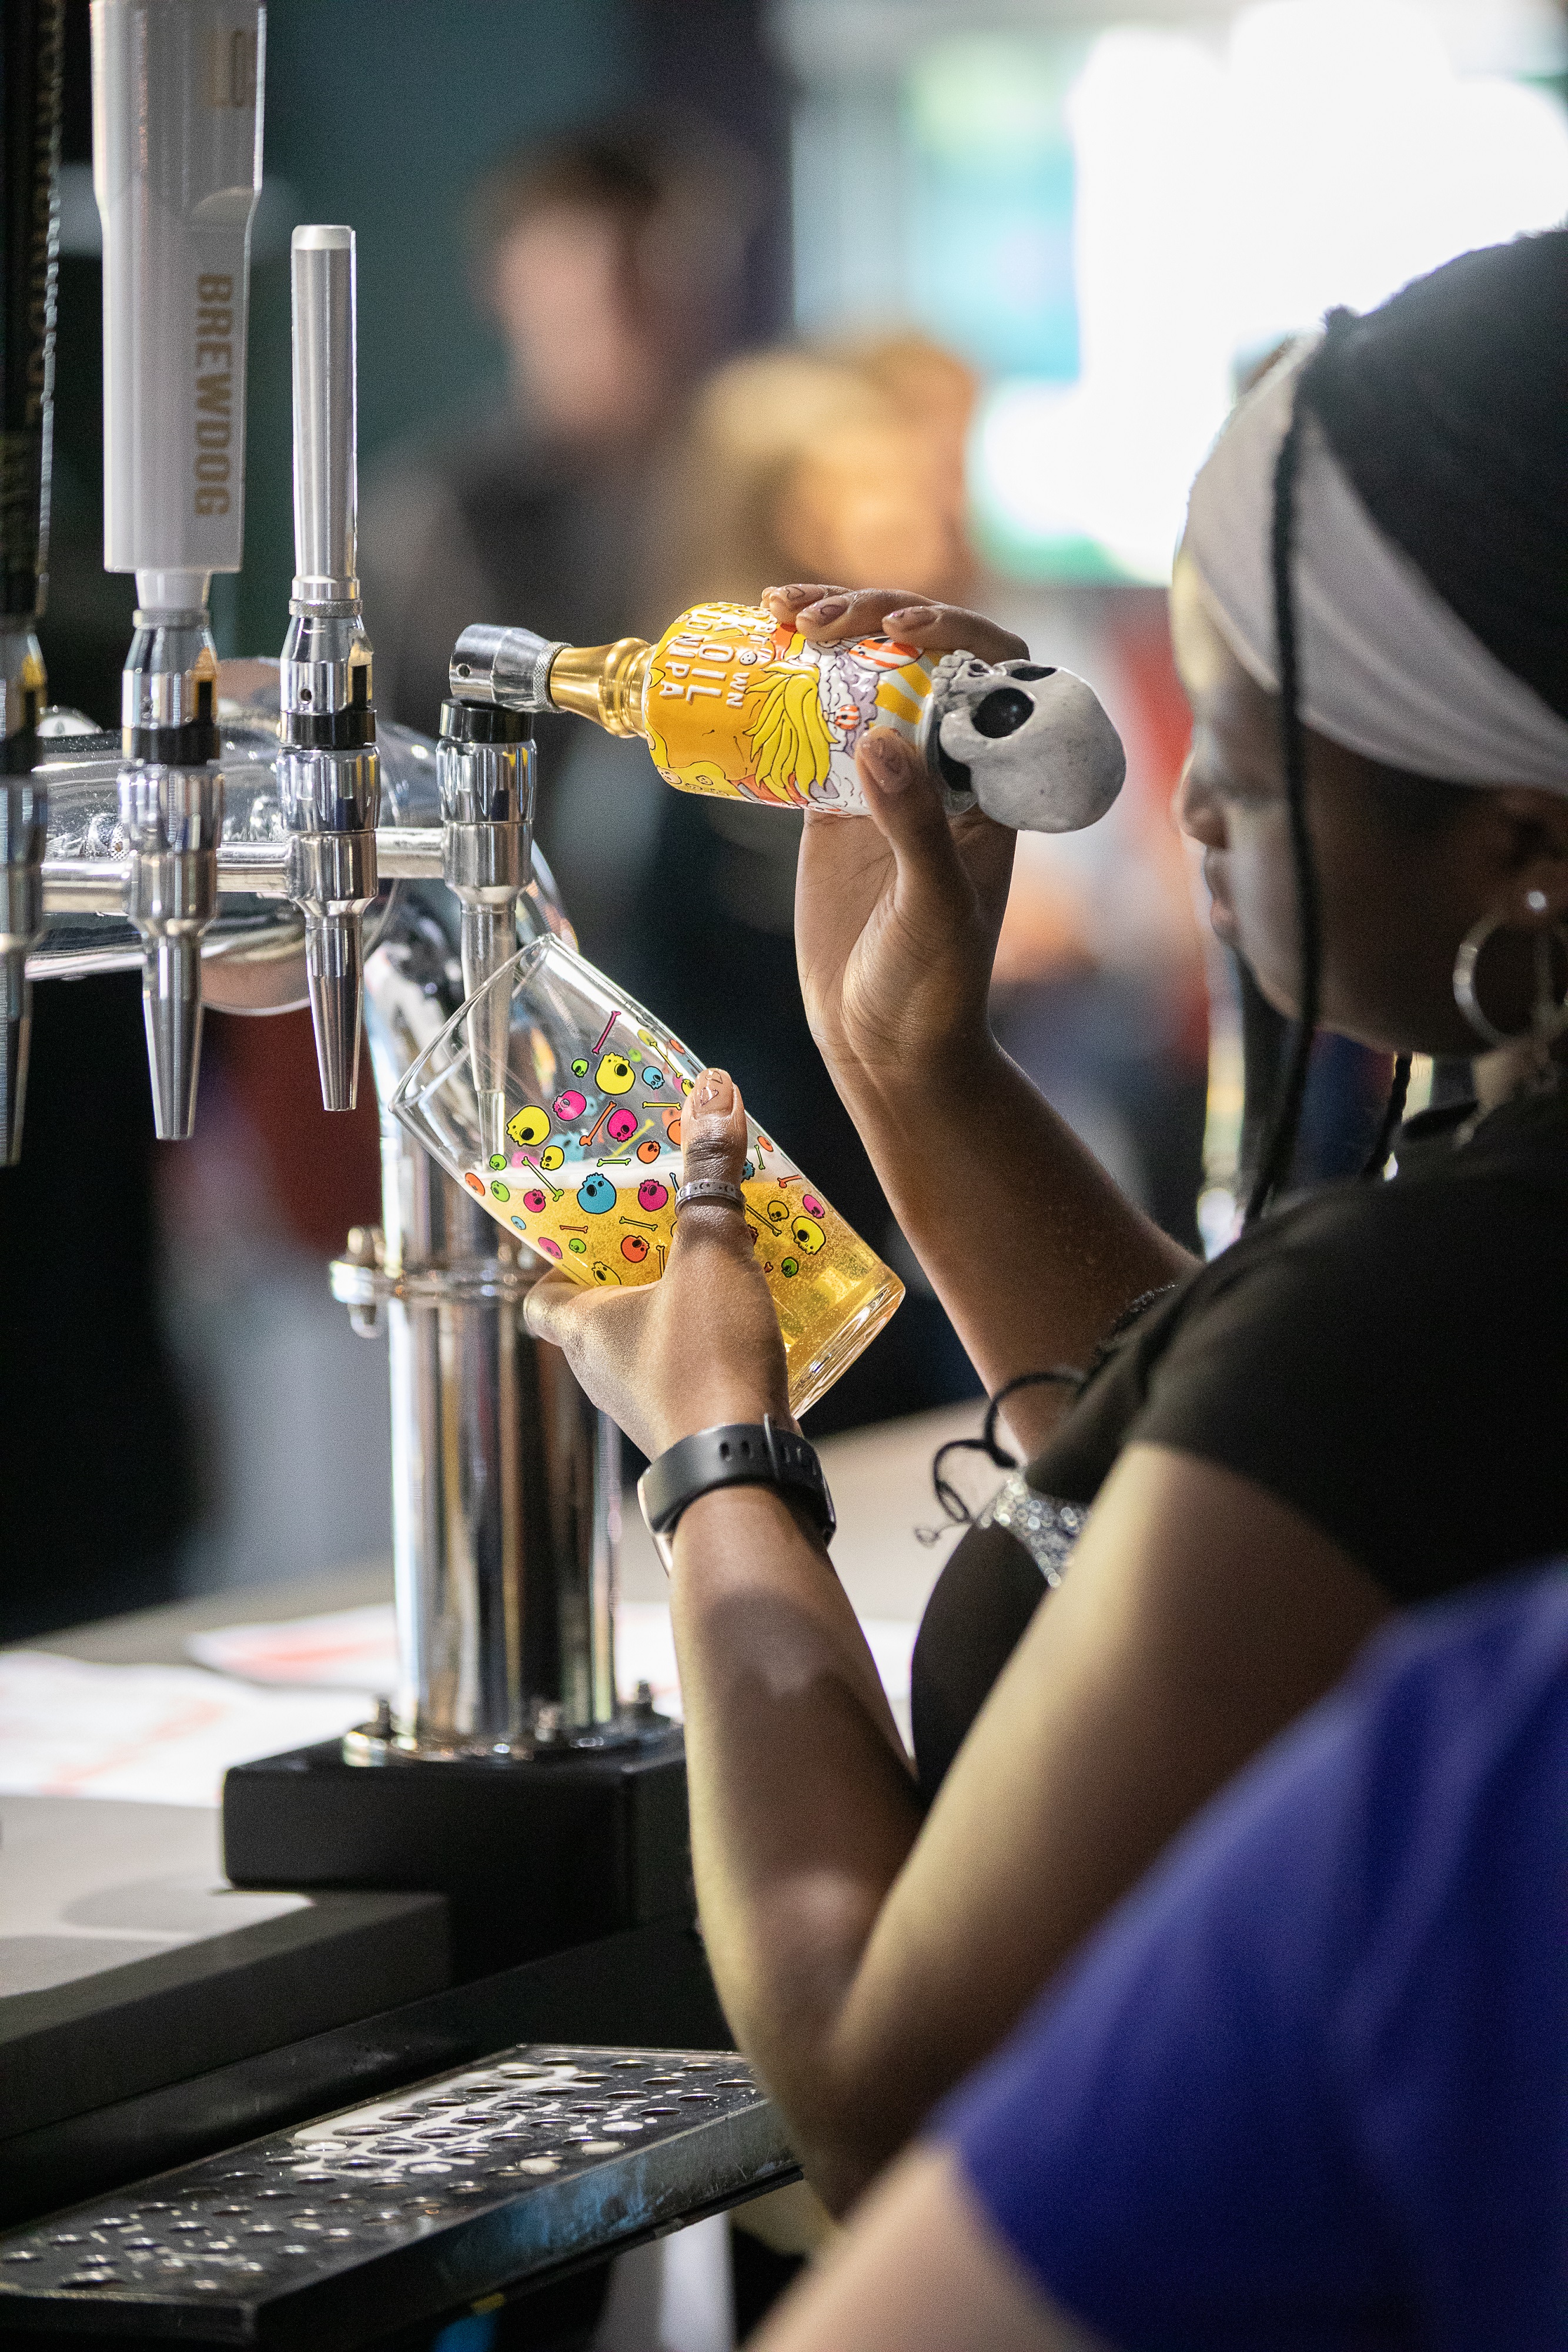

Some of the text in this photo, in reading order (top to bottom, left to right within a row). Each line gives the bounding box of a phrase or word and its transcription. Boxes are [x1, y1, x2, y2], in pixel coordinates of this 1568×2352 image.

[195, 274, 233, 516] BREWDOG
[659, 649, 696, 696] IPA
[686, 644, 734, 701] OIL
